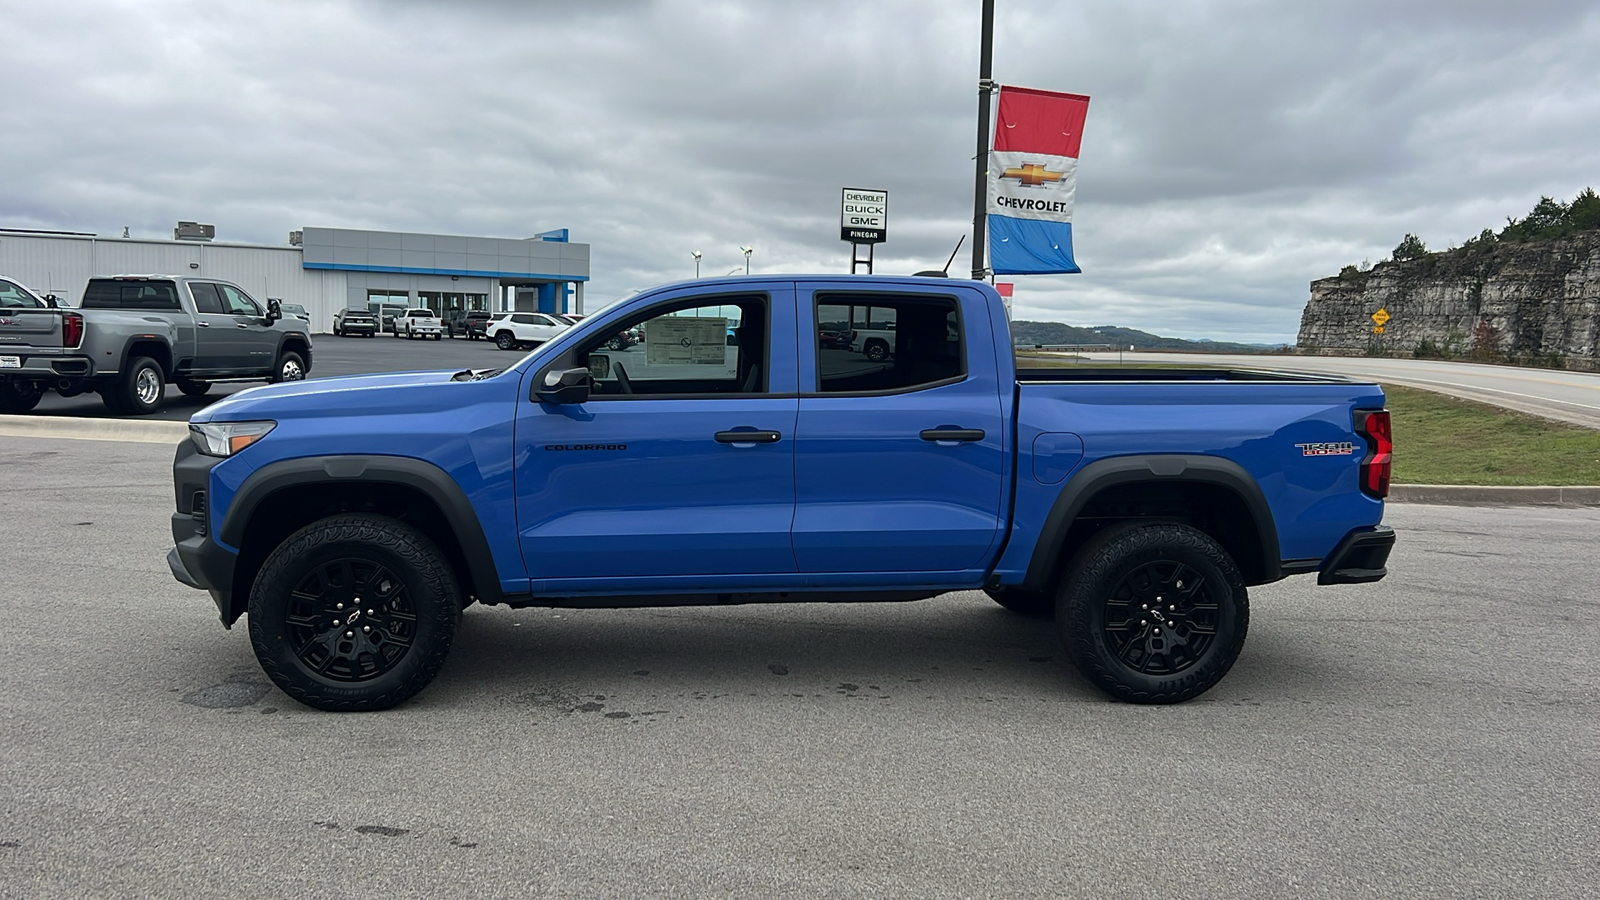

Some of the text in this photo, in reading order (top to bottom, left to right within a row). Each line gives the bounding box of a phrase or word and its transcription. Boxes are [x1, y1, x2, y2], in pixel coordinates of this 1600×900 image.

[846, 193, 884, 203] CHEVROLET
[996, 196, 1067, 213] CHEVROLET
[845, 205, 884, 214] BUICK
[850, 217, 878, 226] GMC
[850, 230, 878, 239] PINEGAR
